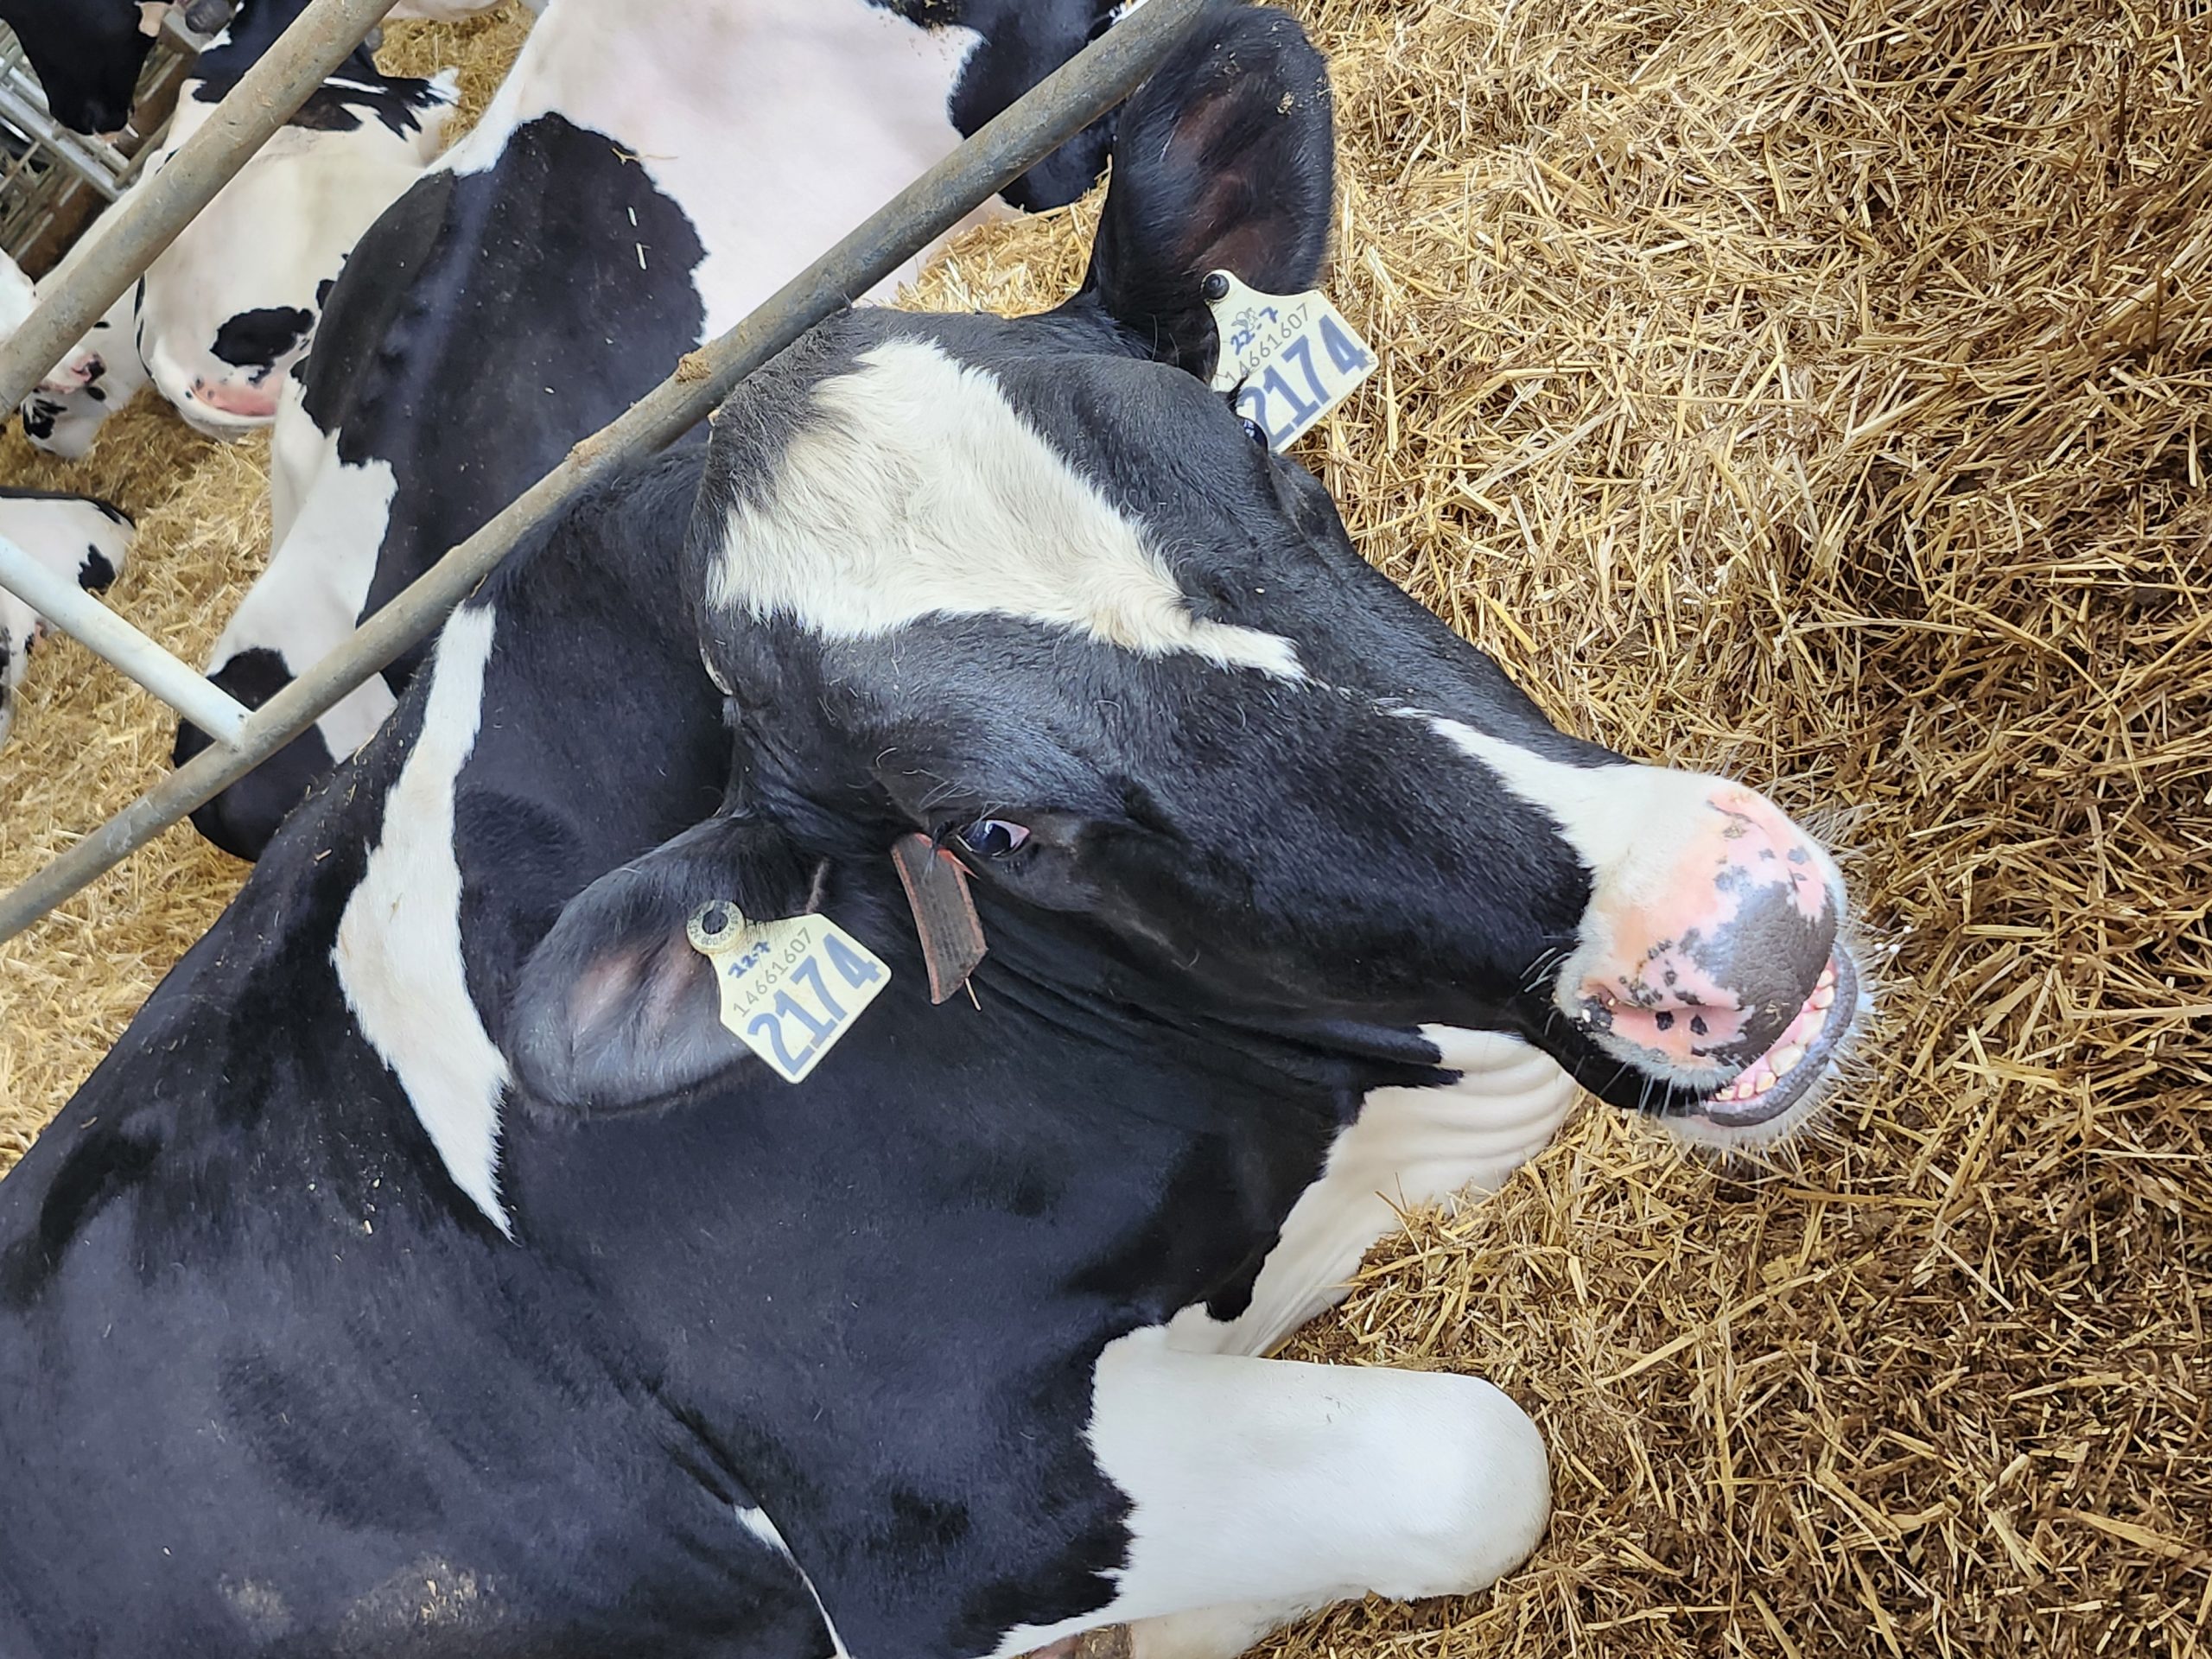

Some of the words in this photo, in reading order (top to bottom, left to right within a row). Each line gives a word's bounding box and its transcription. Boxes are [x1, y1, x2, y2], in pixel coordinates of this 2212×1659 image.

[1225, 303, 1309, 385] 14661607
[1237, 315, 1372, 449] 2174
[733, 926, 813, 1018] 14661607
[747, 933, 882, 1076] 2174
